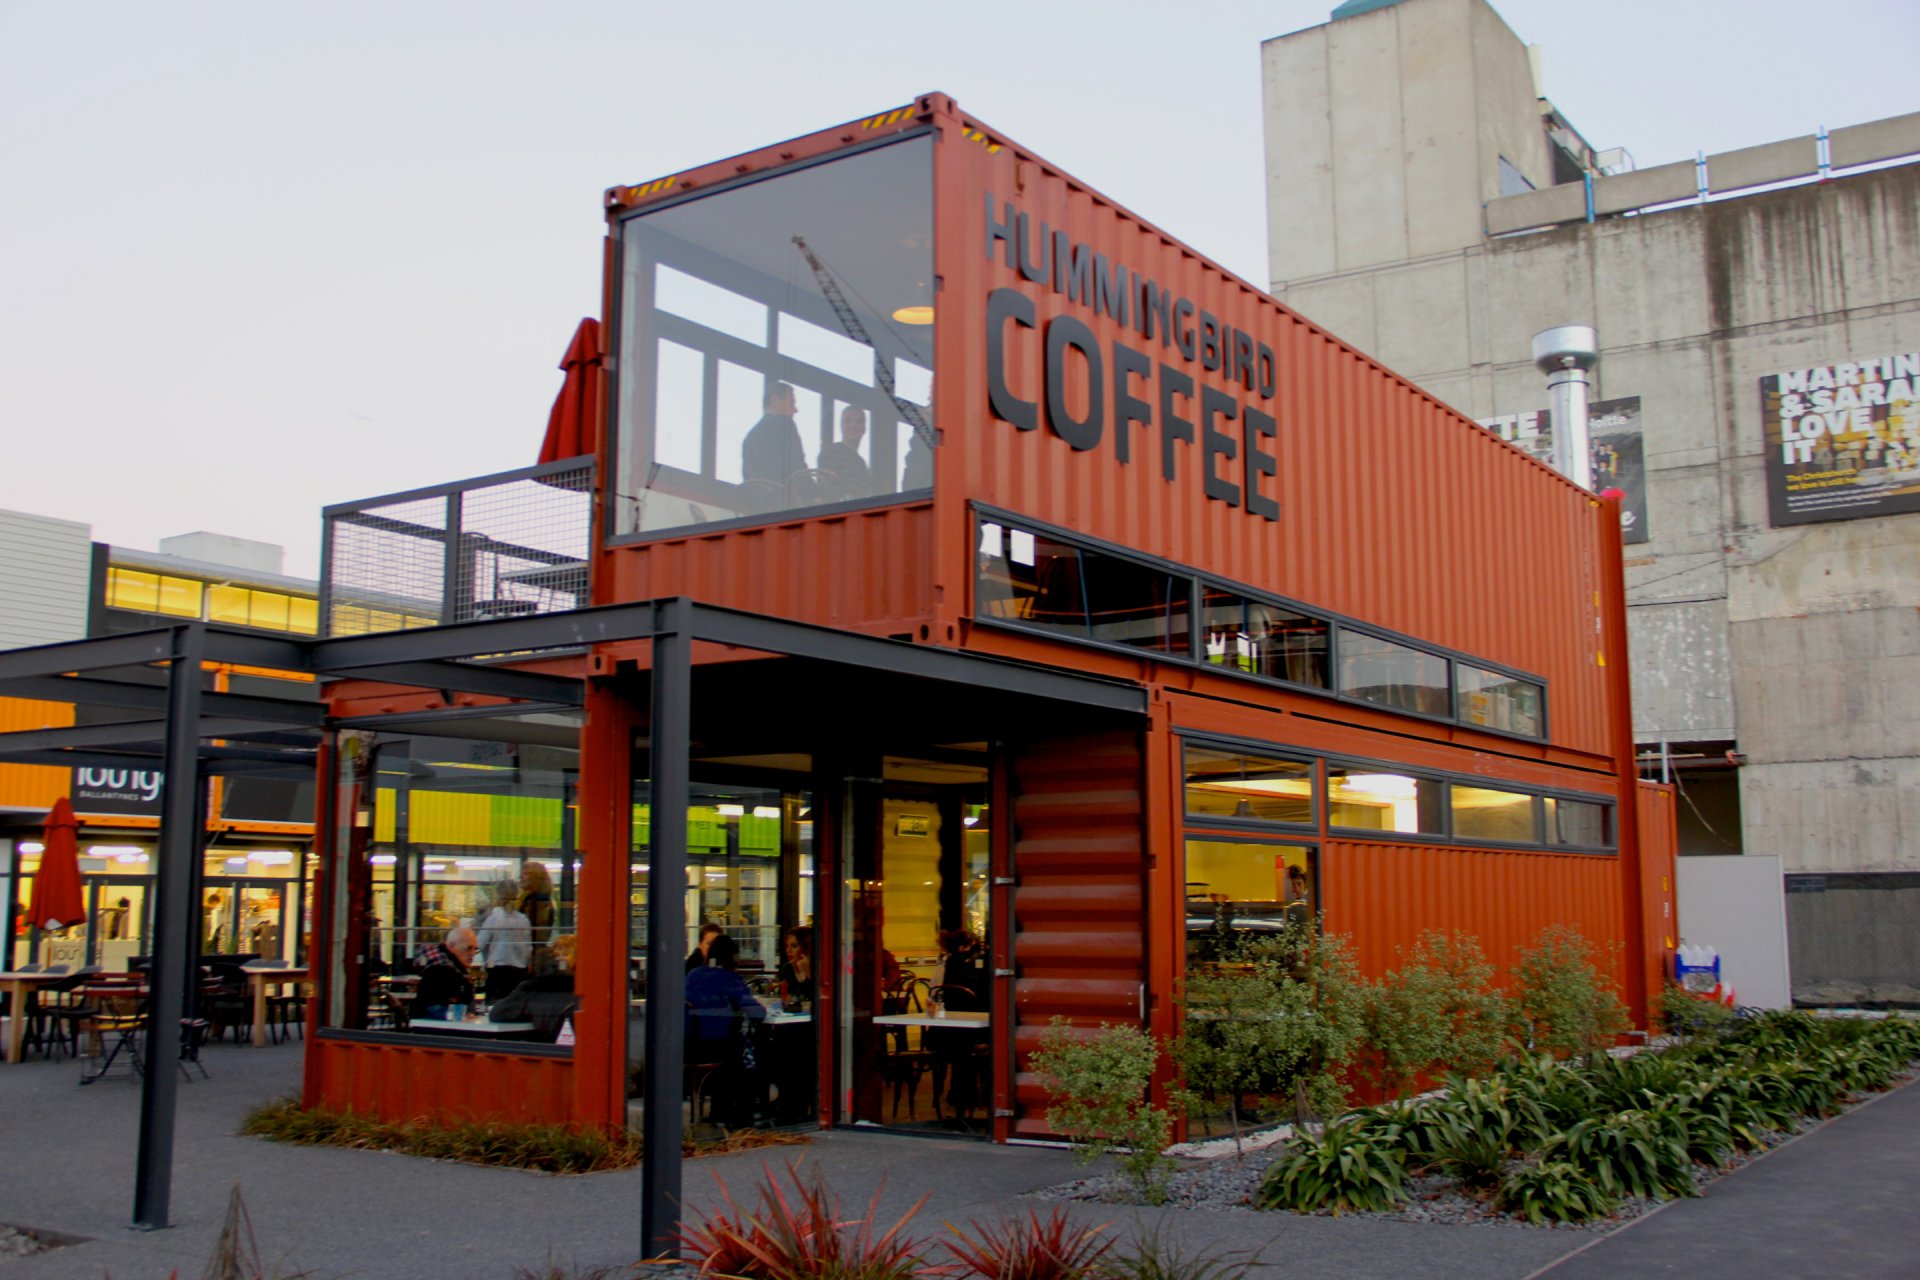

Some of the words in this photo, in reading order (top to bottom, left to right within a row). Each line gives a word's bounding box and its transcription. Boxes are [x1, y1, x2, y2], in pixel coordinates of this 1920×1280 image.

[984, 191, 1276, 399] HUMMINGBIRD
[1777, 352, 1920, 395] MARTIN
[987, 287, 1280, 522] COFFEE
[1779, 394, 1815, 418] &
[1781, 407, 1873, 442] LOVE
[1783, 438, 1817, 465] IT
